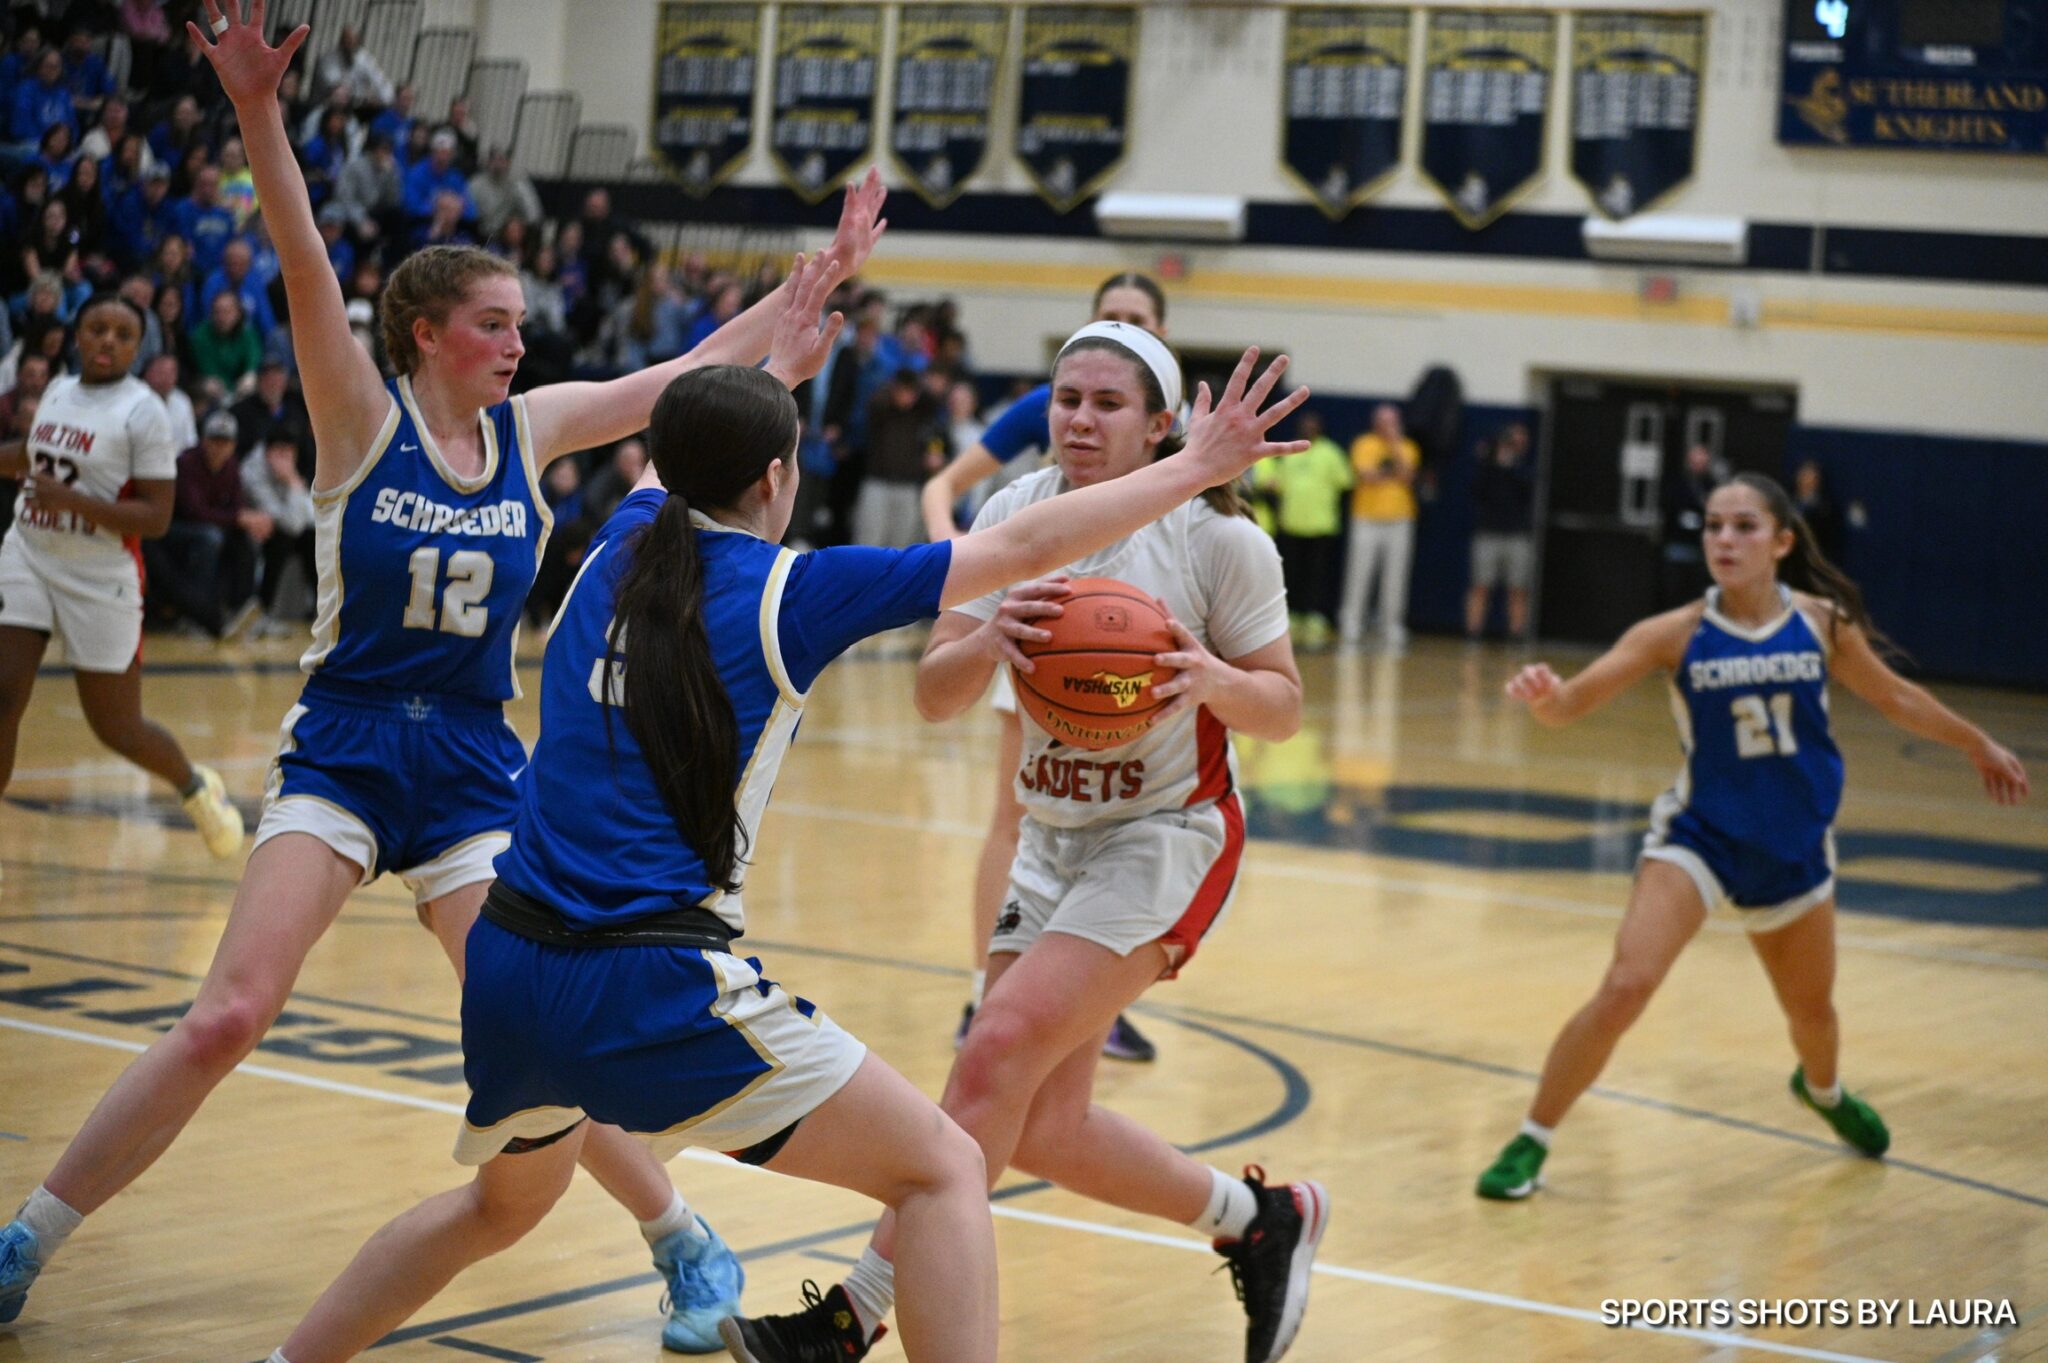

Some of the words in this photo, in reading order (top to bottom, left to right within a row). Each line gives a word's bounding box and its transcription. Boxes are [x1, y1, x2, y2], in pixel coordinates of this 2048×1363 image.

[32, 424, 96, 453] HILTON
[371, 487, 526, 538] SCHROEDER
[402, 546, 494, 638] 12
[1064, 676, 1142, 695] NYSPHSAA
[1689, 651, 1821, 692] SCHROEDER
[1731, 692, 1798, 759] 21
